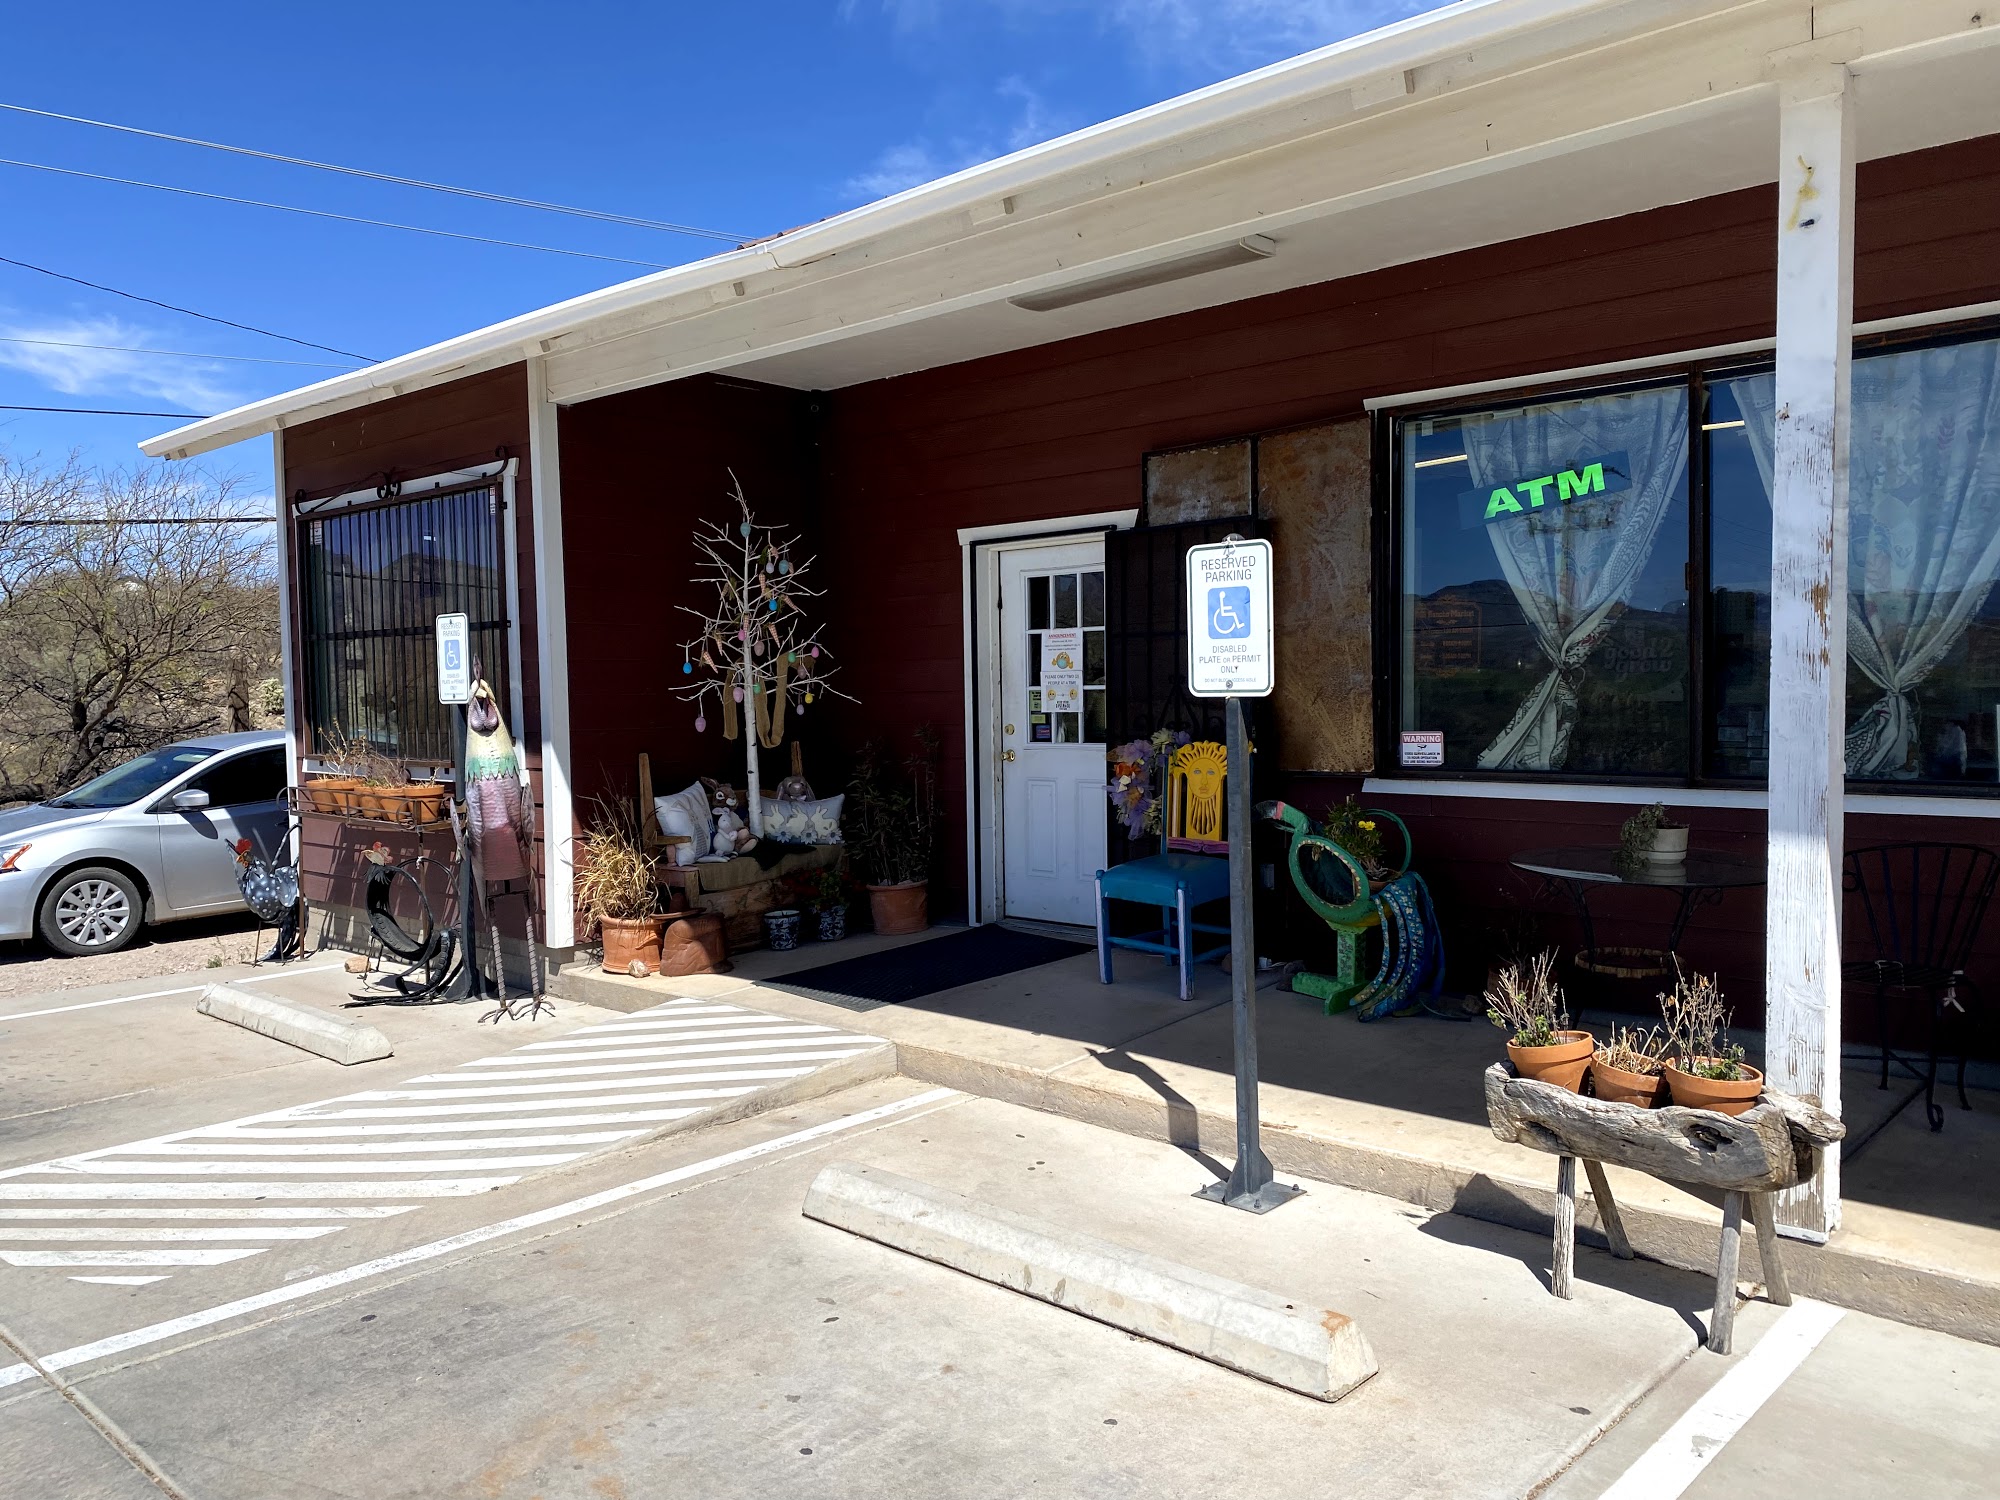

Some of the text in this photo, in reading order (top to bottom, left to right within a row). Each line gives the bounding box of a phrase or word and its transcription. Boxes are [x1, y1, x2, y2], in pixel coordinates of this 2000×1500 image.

[1484, 462, 1605, 519] ATM
[1201, 555, 1256, 571] RESERVED
[1205, 568, 1252, 583] PARKING
[1212, 644, 1247, 654] DISABLED
[1198, 655, 1221, 664] PLATE
[1232, 654, 1261, 663] PERMIT
[1220, 665, 1239, 674] ONLY
[1403, 735, 1441, 743] WARNING
